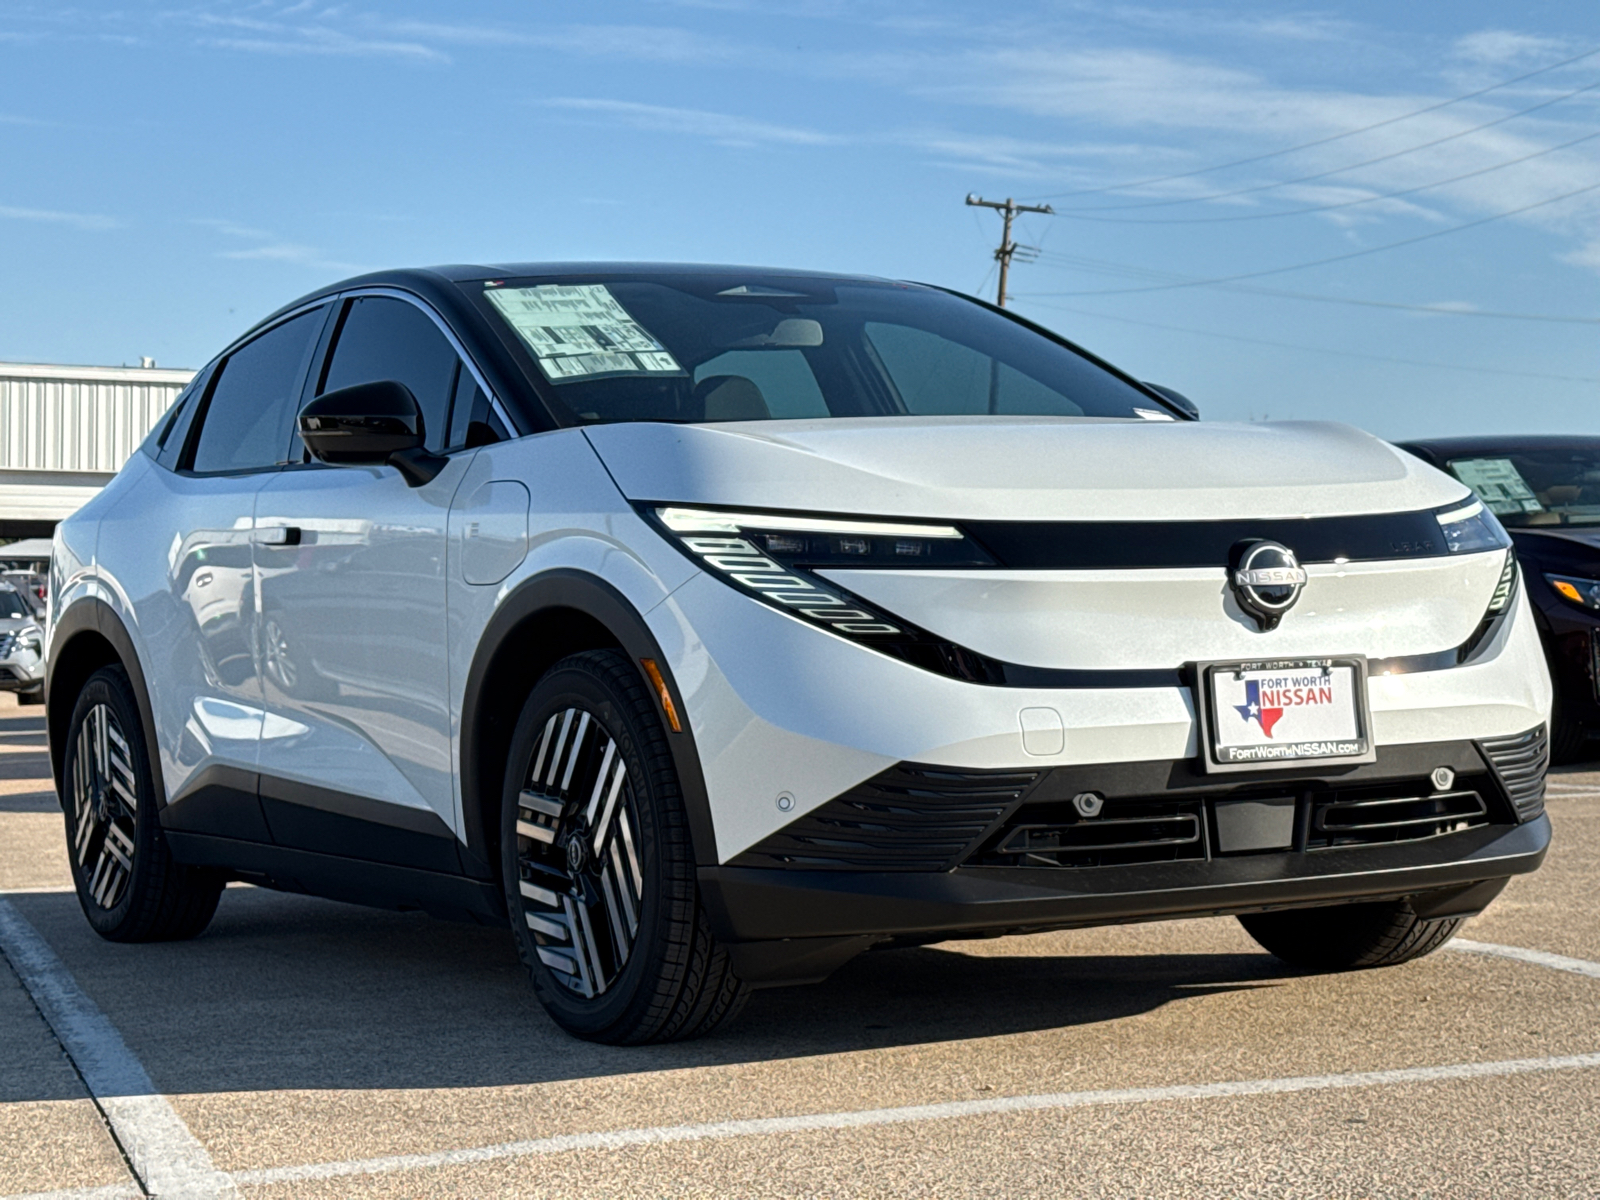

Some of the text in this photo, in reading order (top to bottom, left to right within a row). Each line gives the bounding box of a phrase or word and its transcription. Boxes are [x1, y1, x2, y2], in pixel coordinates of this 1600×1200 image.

[1390, 540, 1433, 553] LEAF
[1237, 571, 1304, 583] NISSAN
[1240, 662, 1262, 671] FORT
[1265, 661, 1295, 670] WORTH
[1261, 675, 1331, 689] FORT WORTH
[1261, 687, 1333, 707] NISSAN
